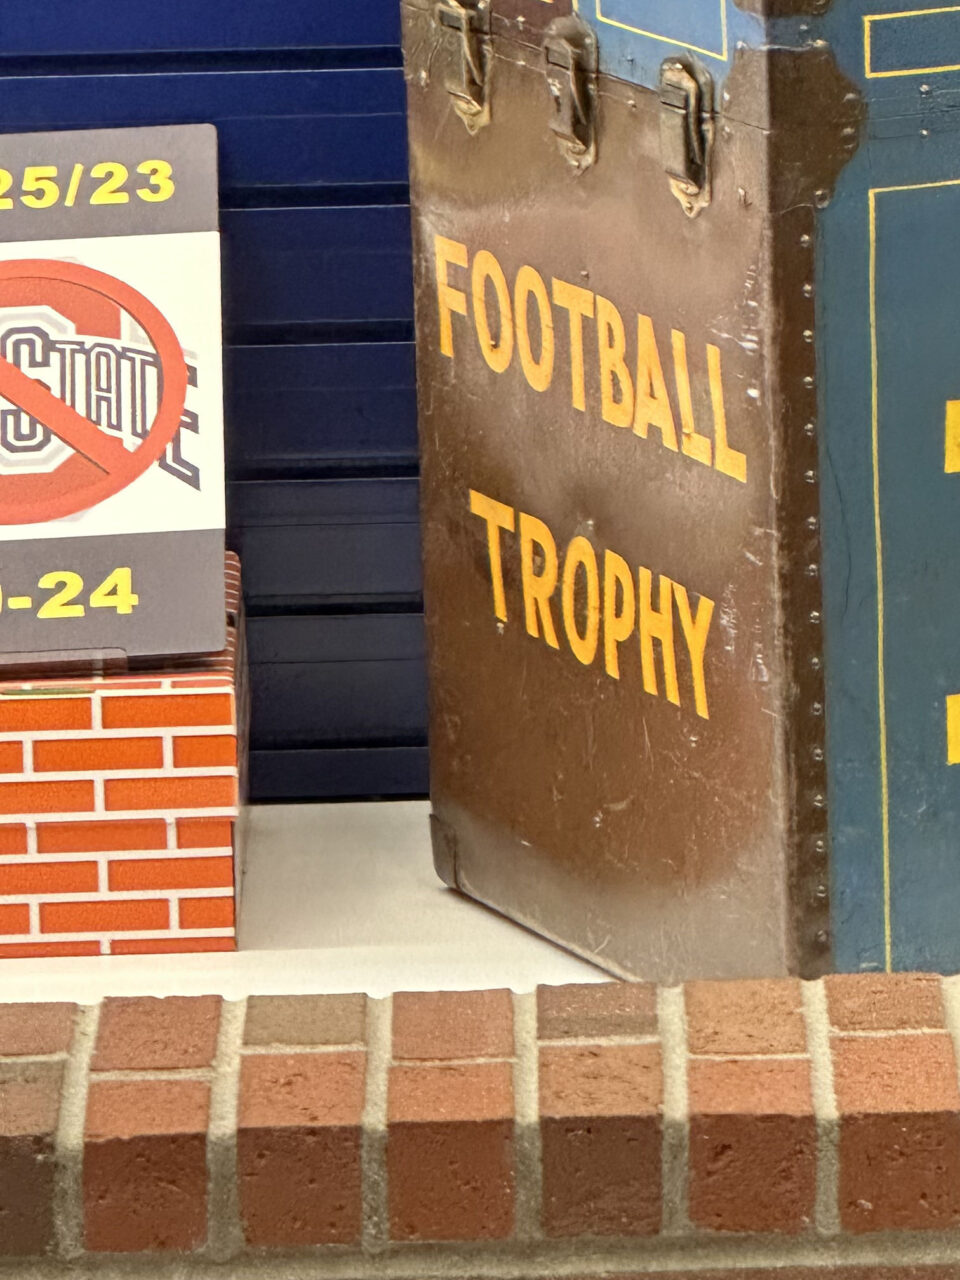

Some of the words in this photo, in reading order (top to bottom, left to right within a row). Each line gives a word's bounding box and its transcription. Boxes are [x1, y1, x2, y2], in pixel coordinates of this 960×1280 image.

[434, 235, 748, 483] FOOTBALL
[0, 567, 139, 619] -24
[469, 489, 714, 720] TROPHY
